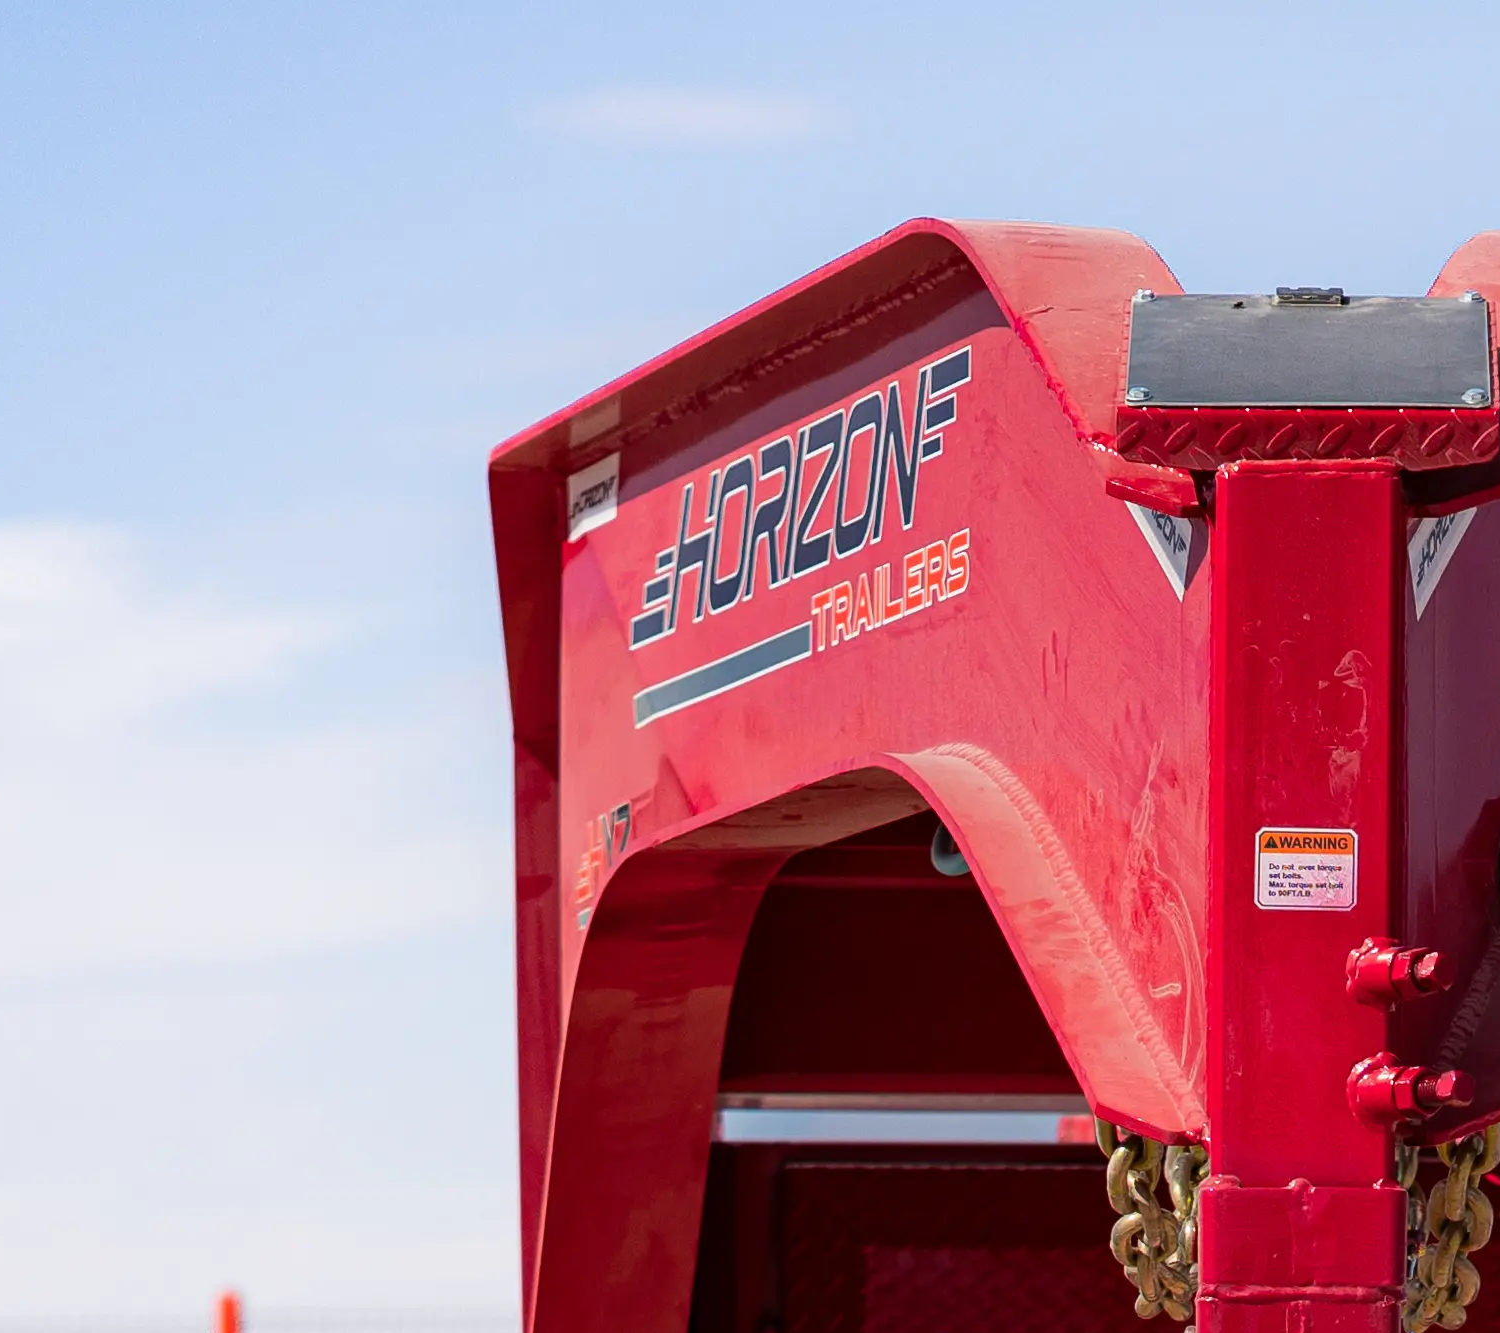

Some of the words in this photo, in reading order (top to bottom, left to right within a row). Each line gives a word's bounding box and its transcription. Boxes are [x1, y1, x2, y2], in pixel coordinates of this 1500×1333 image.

[629, 344, 972, 651] HORIZON
[811, 527, 971, 652] TRAILERS
[1279, 836, 1349, 850] WARNING
[1268, 863, 1280, 871] Do
[1281, 863, 1295, 871] not
[1317, 864, 1342, 872] torque
[1288, 881, 1313, 890] torque
